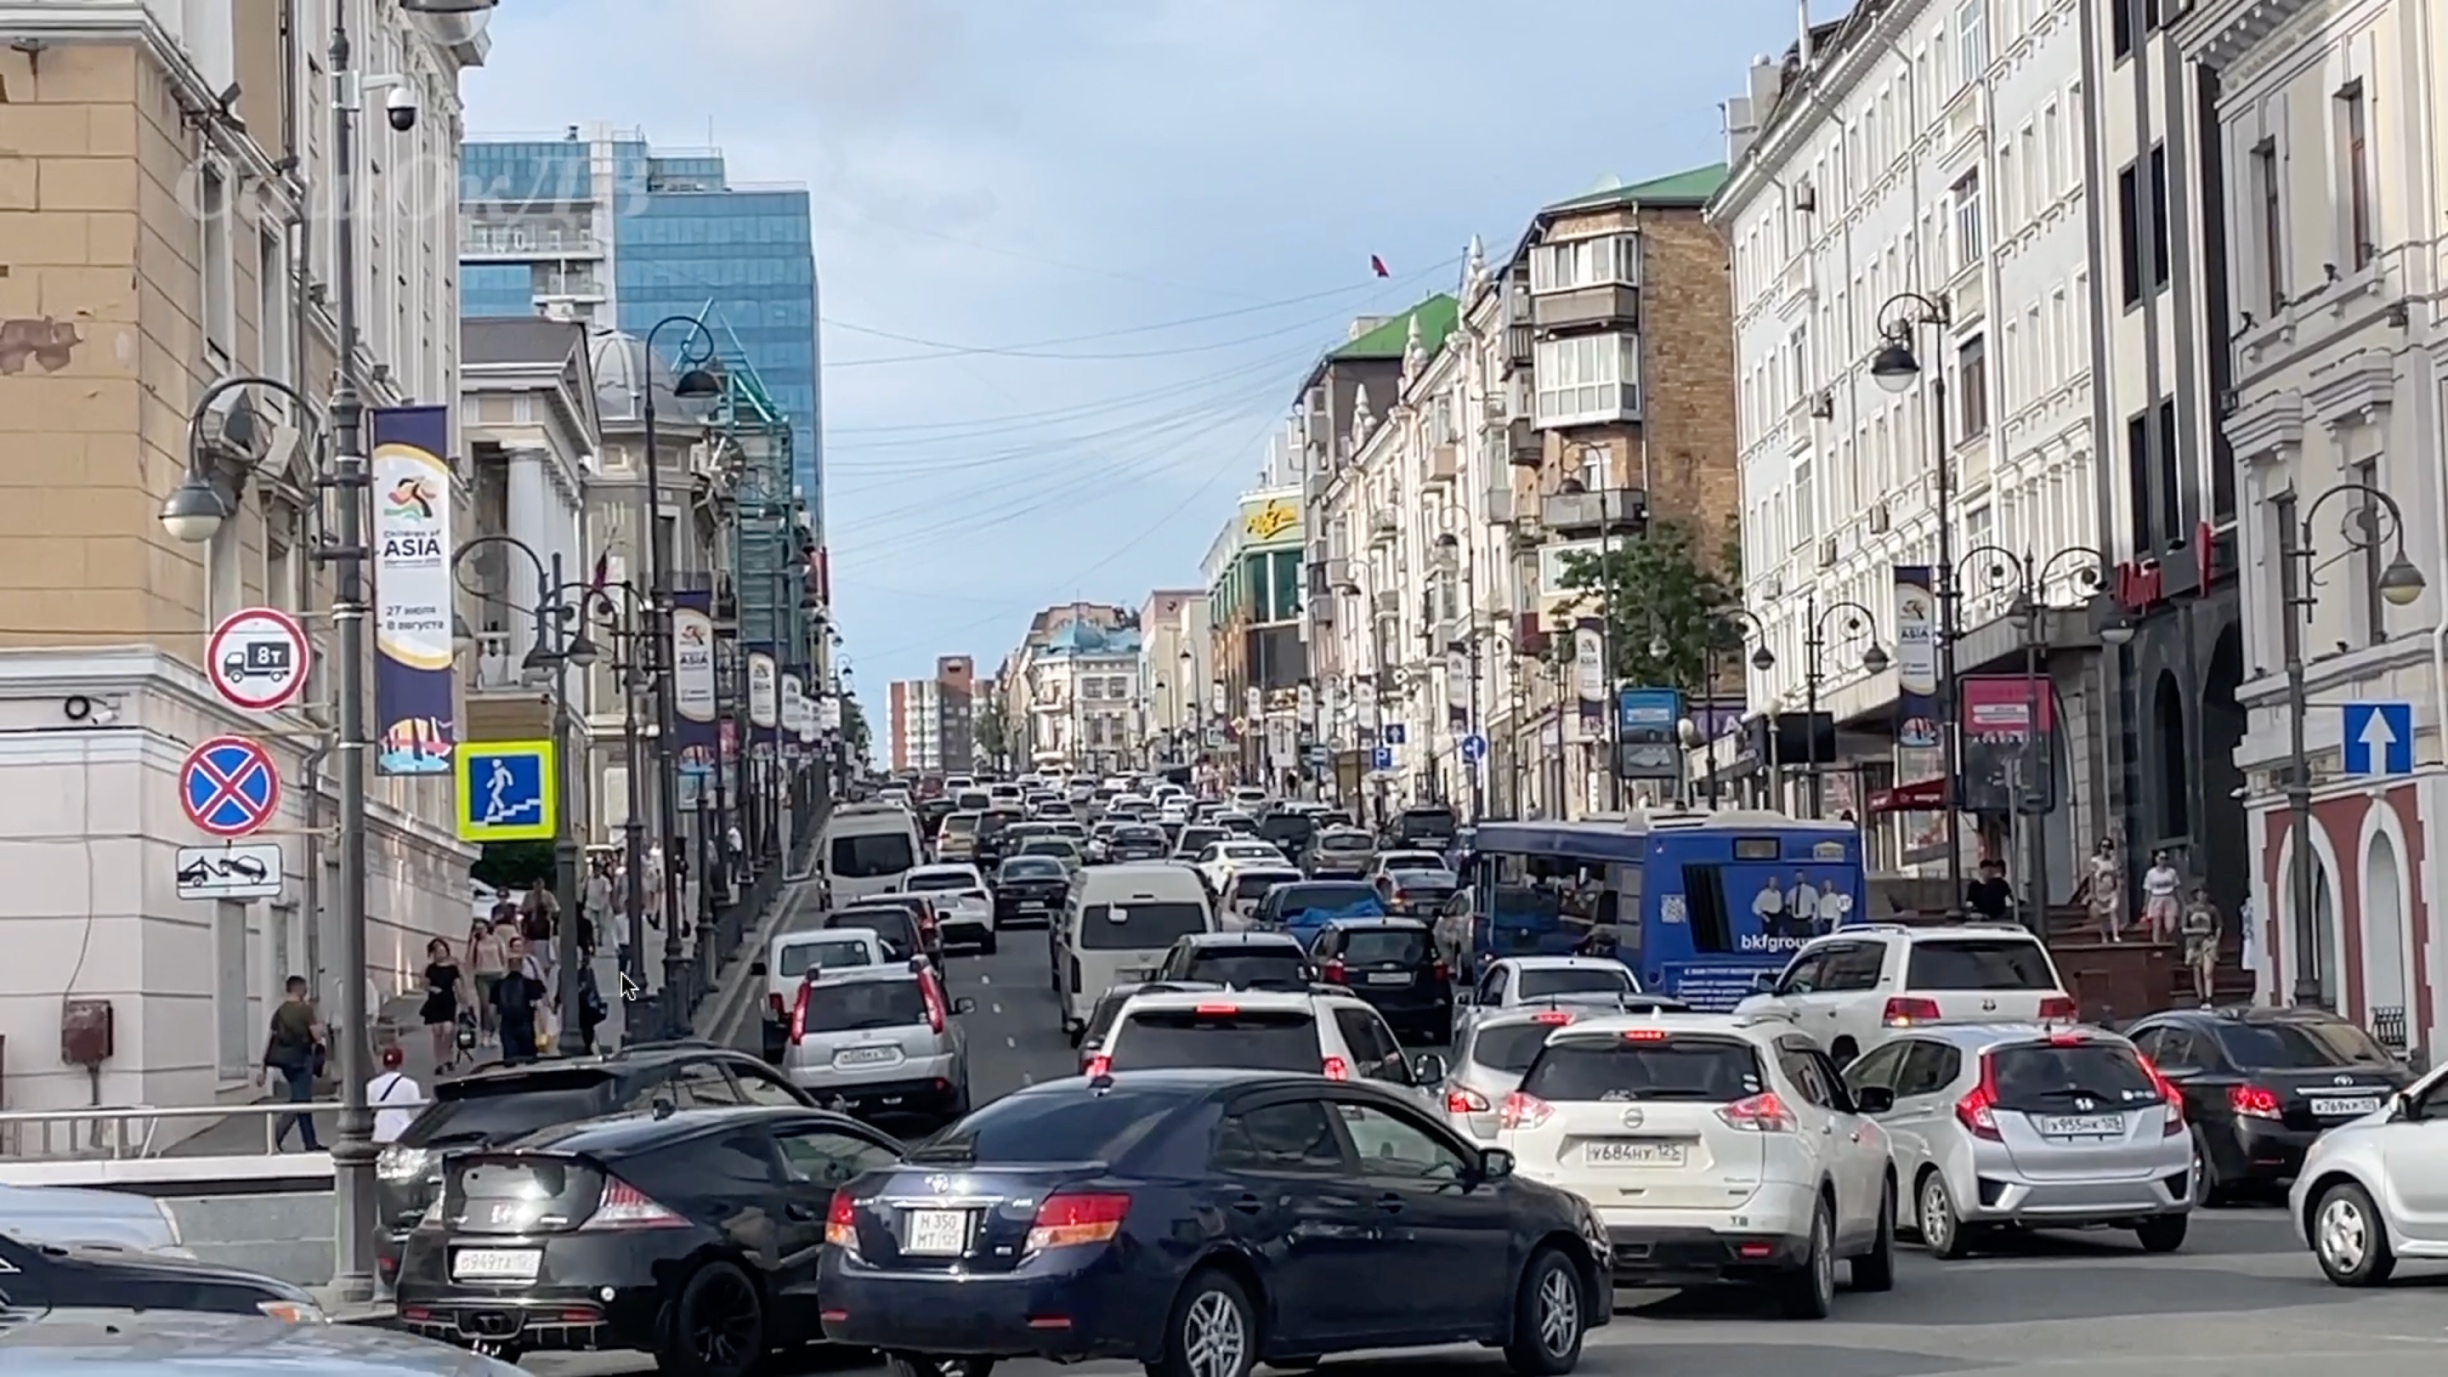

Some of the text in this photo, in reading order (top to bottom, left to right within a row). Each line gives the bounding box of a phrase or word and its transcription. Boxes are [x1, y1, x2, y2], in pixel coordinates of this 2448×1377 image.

[384, 538, 441, 557] ASIA
[386, 605, 401, 617] 27
[1376, 749, 1388, 767] P
[1741, 934, 1809, 953] bkfgrou
